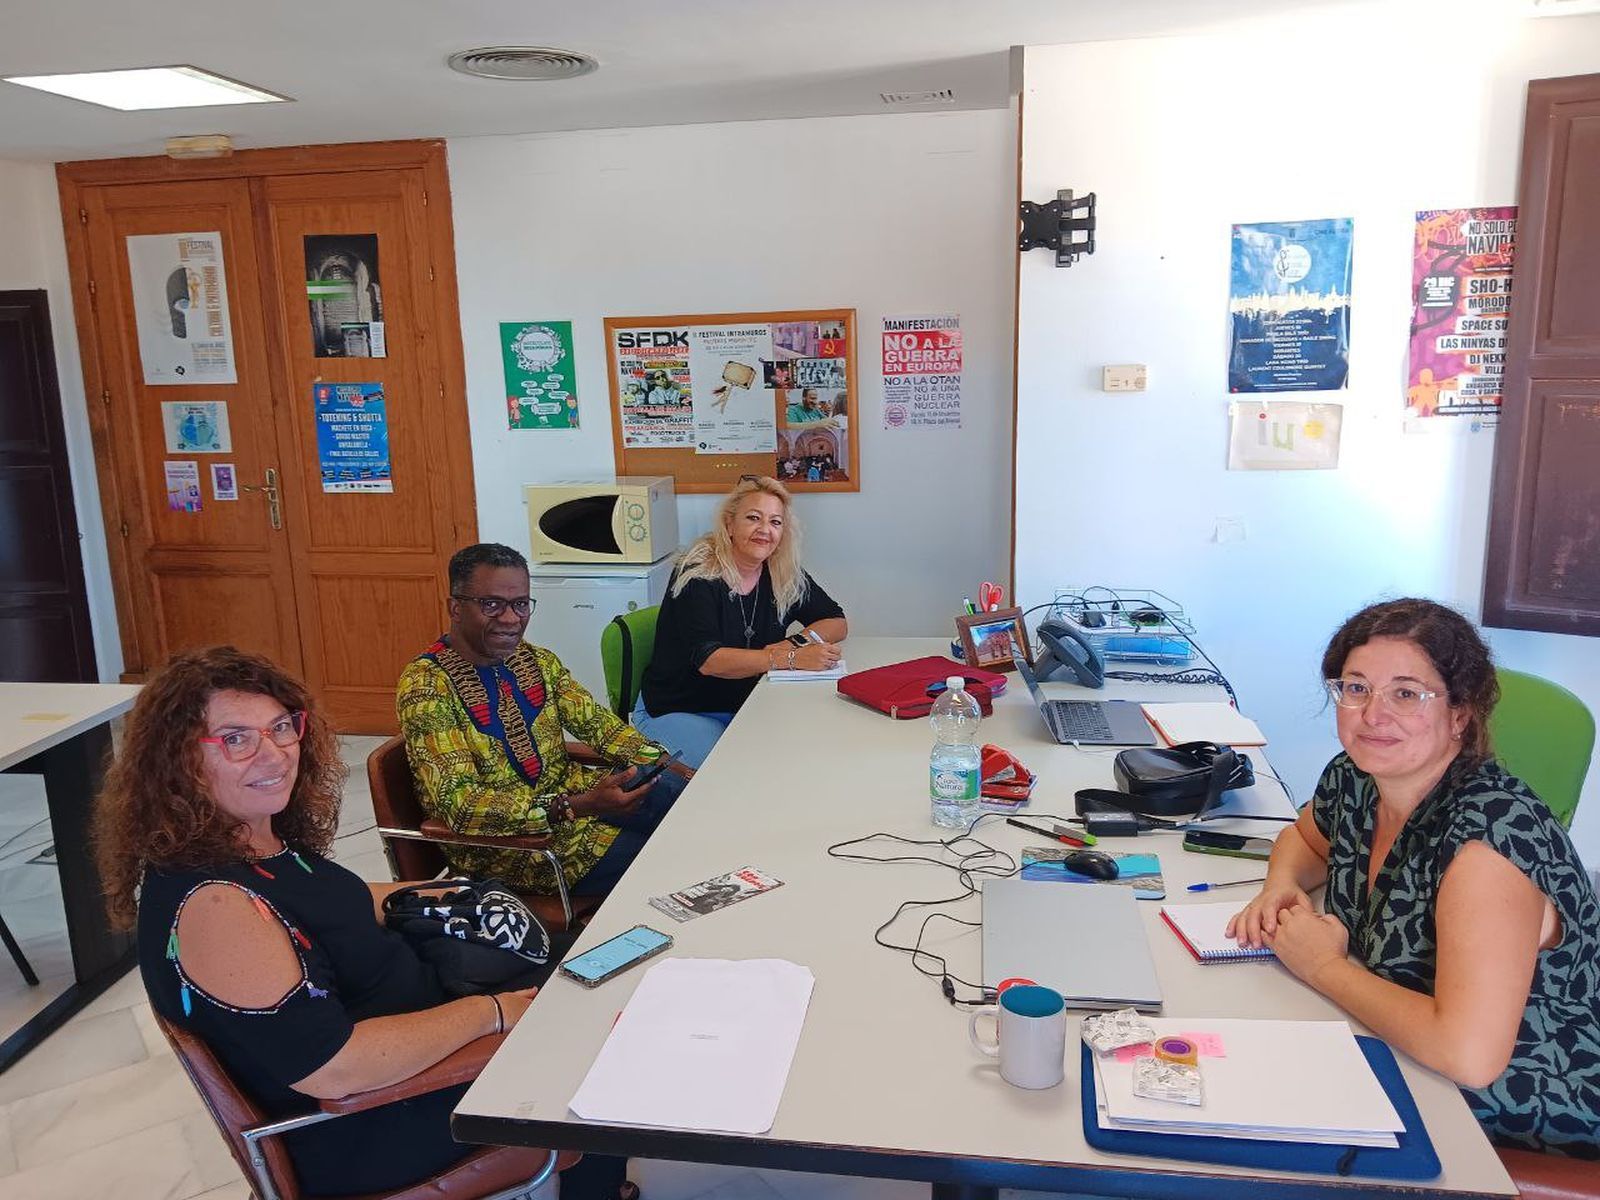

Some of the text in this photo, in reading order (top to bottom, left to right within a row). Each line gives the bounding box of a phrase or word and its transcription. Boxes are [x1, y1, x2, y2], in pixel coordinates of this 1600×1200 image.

[1468, 222, 1481, 235] NO
[1483, 220, 1506, 234] SOLO
[1461, 320, 1493, 331] SPACE
[727, 329, 767, 337] INTRAMUROS
[617, 330, 690, 348] SFDK
[883, 333, 960, 351] NO A LA
[1440, 338, 1459, 349] LAS
[1460, 337, 1496, 349] NINYAS
[884, 348, 960, 363] GUERRA
[1469, 354, 1481, 365] DJ
[884, 361, 960, 372] EN EUROPA
[883, 375, 960, 386] NO A LA OTAN
[914, 393, 960, 401] GUERRA
[914, 400, 960, 410] NUCLEAR
